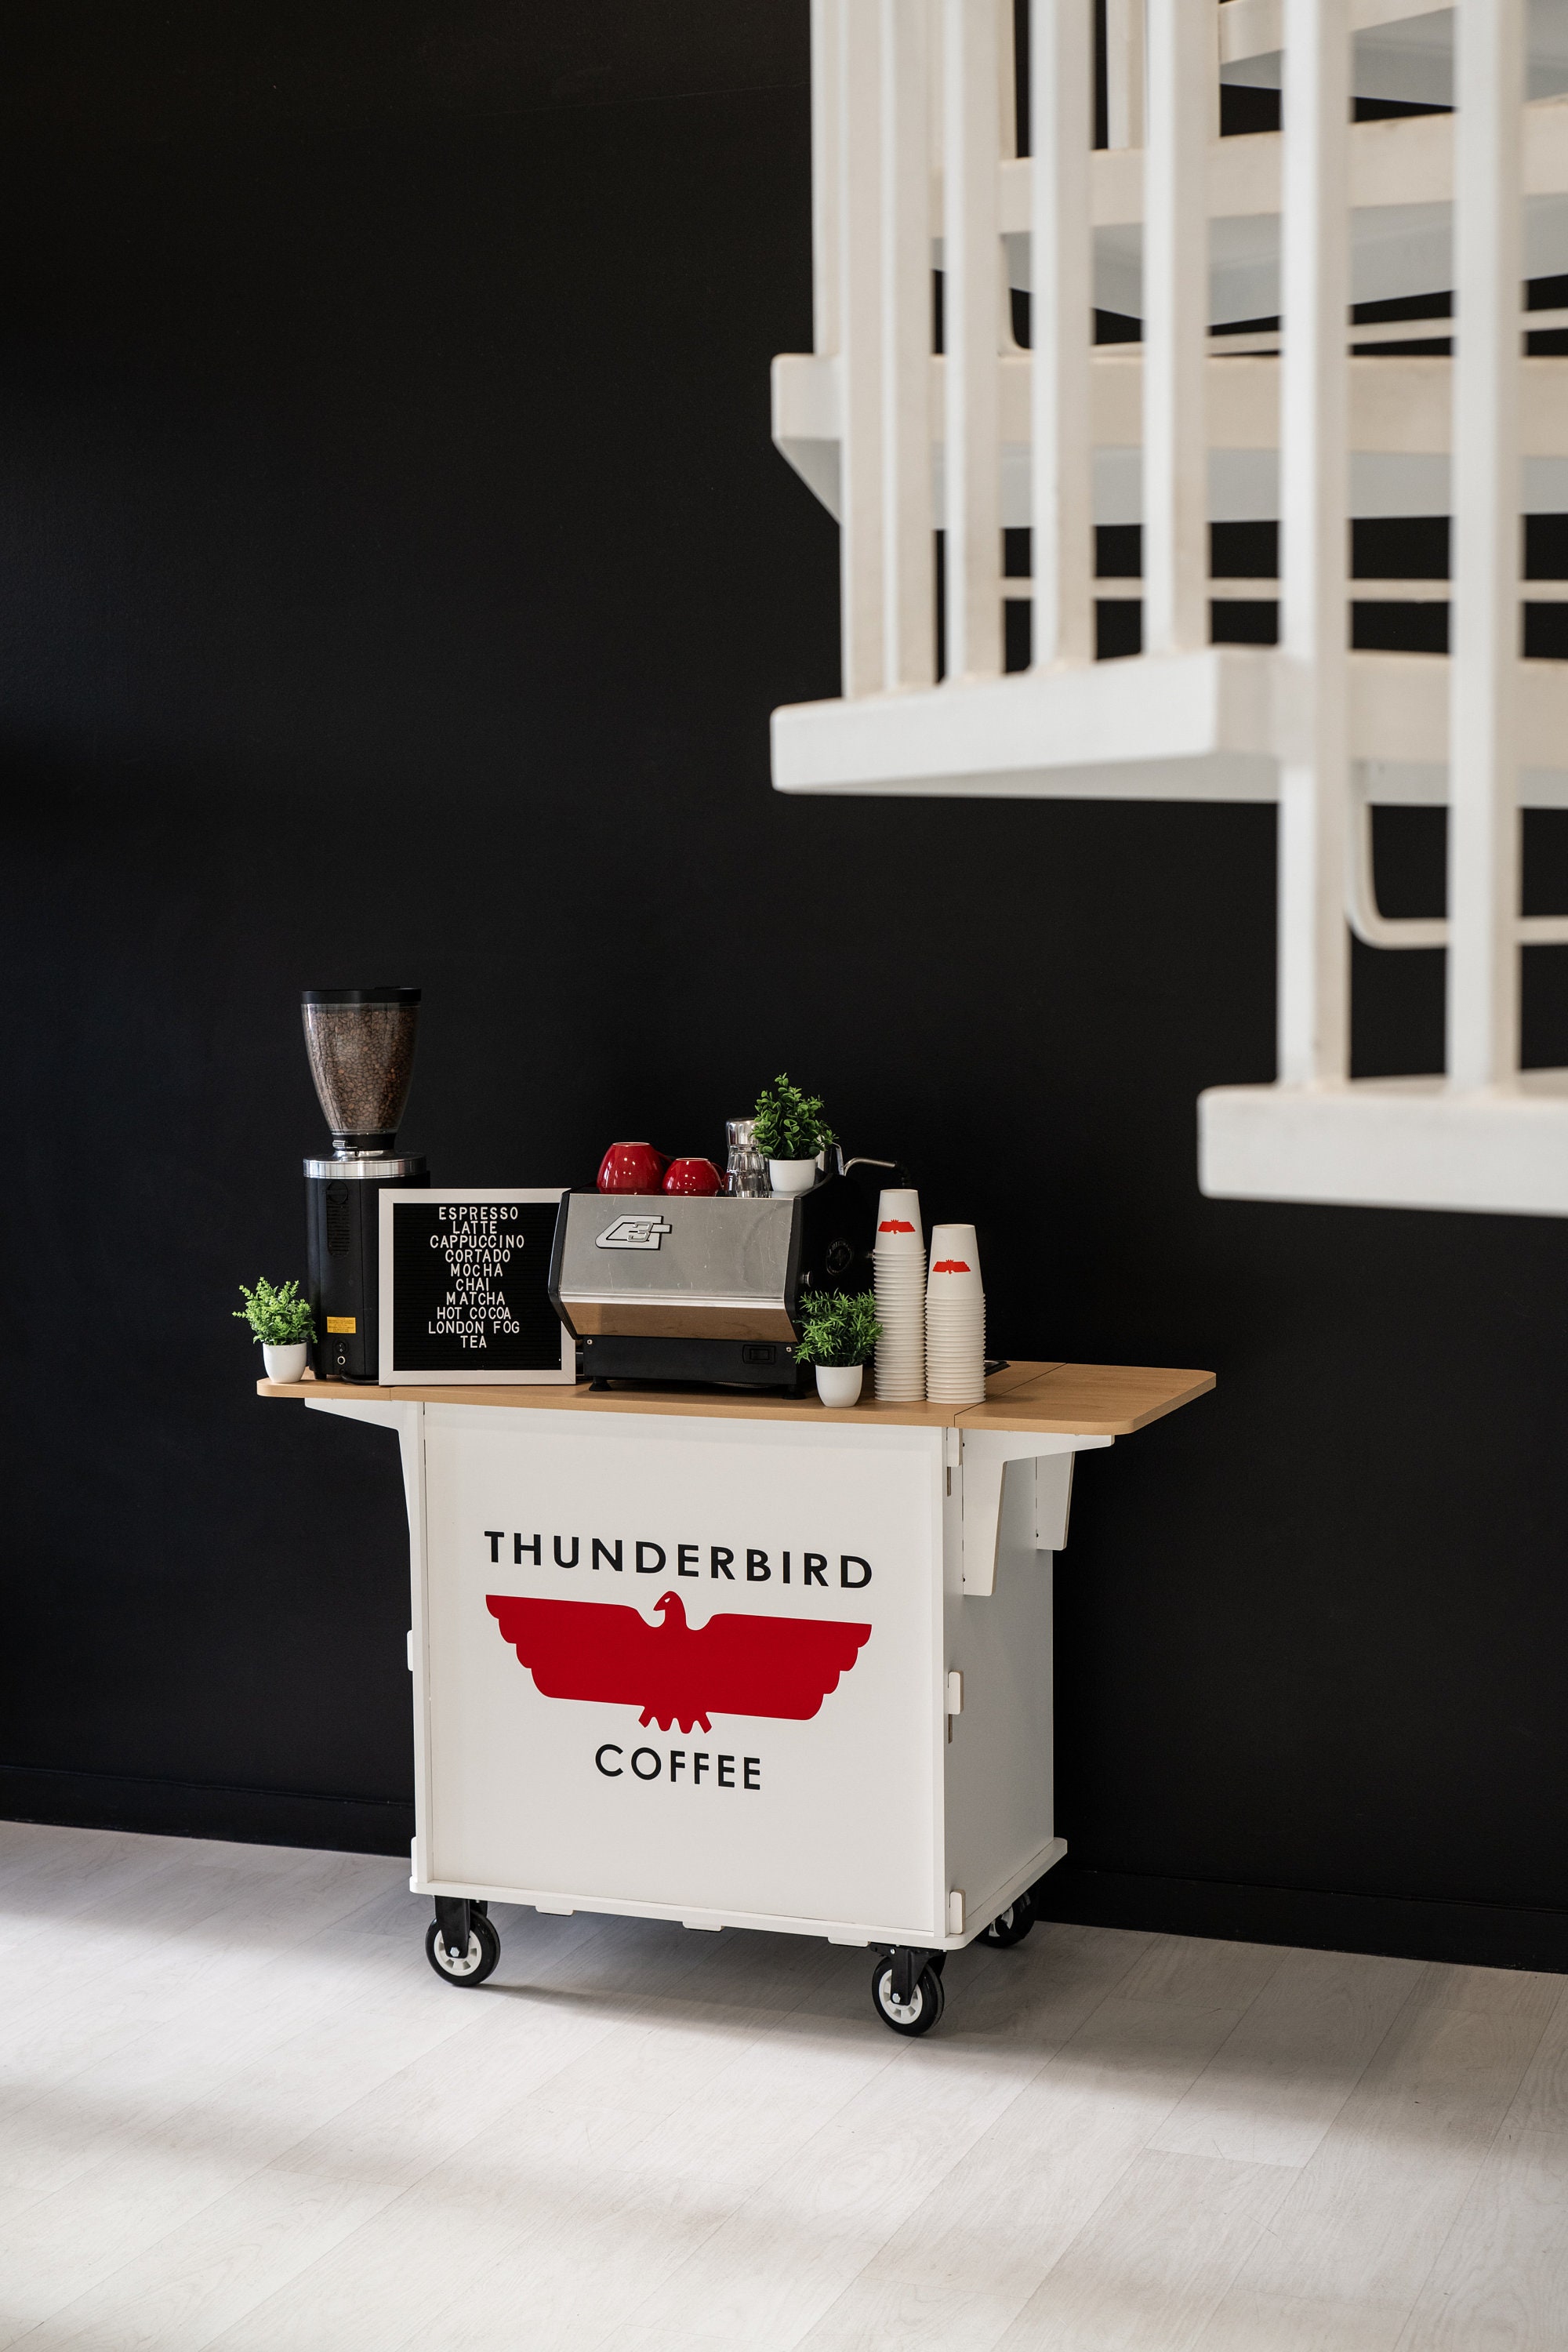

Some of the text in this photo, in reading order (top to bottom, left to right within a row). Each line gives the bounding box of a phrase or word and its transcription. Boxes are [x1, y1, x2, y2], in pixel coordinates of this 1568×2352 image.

[439, 1207, 517, 1220] ESPRESSO
[453, 1221, 497, 1234] LATTE
[430, 1235, 524, 1248] CAPPUCCINO
[445, 1249, 510, 1262] CORTADO
[451, 1263, 503, 1276] MOCHA
[456, 1278, 488, 1291] CHAI
[447, 1292, 505, 1305] MATCHA
[437, 1307, 511, 1319] HOT COCOA
[429, 1321, 519, 1334] LONDON FOG
[460, 1336, 486, 1348] TEA
[485, 1531, 872, 1588] THUNDERBIRD
[596, 1744, 760, 1790] COFFEE
